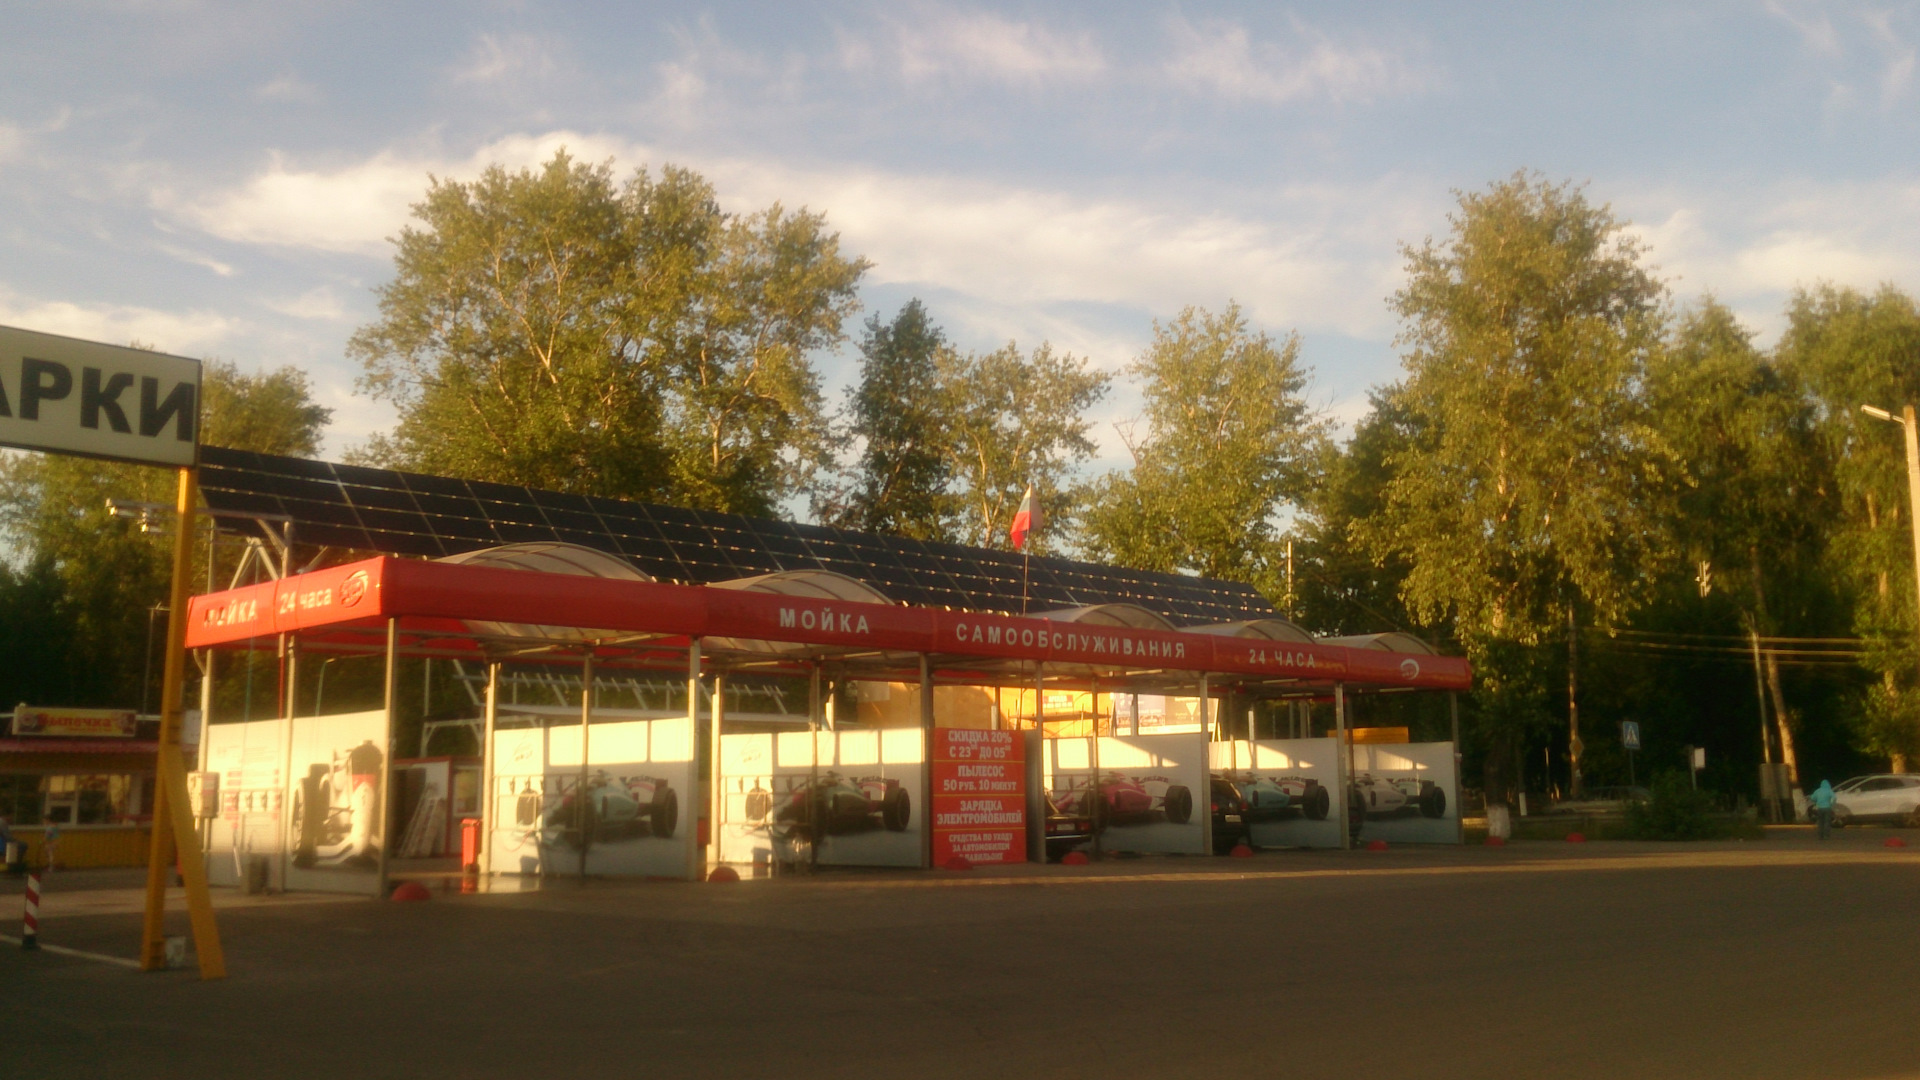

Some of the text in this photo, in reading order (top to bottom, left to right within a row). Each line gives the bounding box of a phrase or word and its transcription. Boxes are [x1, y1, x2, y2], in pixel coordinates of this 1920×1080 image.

[0, 357, 195, 442] РКИ
[279, 591, 296, 614] 24
[300, 588, 332, 609] часа
[779, 607, 1315, 668] МОЙКА САМООБСЛУЖИВАНИЯ 24 ЧАСА
[948, 730, 1012, 743] СКИДКА 20%
[949, 746, 956, 757] С
[979, 747, 991, 759] ДО
[958, 766, 1004, 777] ПЫЛЕСОС
[943, 779, 1016, 791] 50 РУБ. 10 МИНУТ
[960, 800, 1002, 812] ЗАРЯДКА
[937, 810, 1022, 825] ЭЛЕКТРОМОБИЛЕЙ
